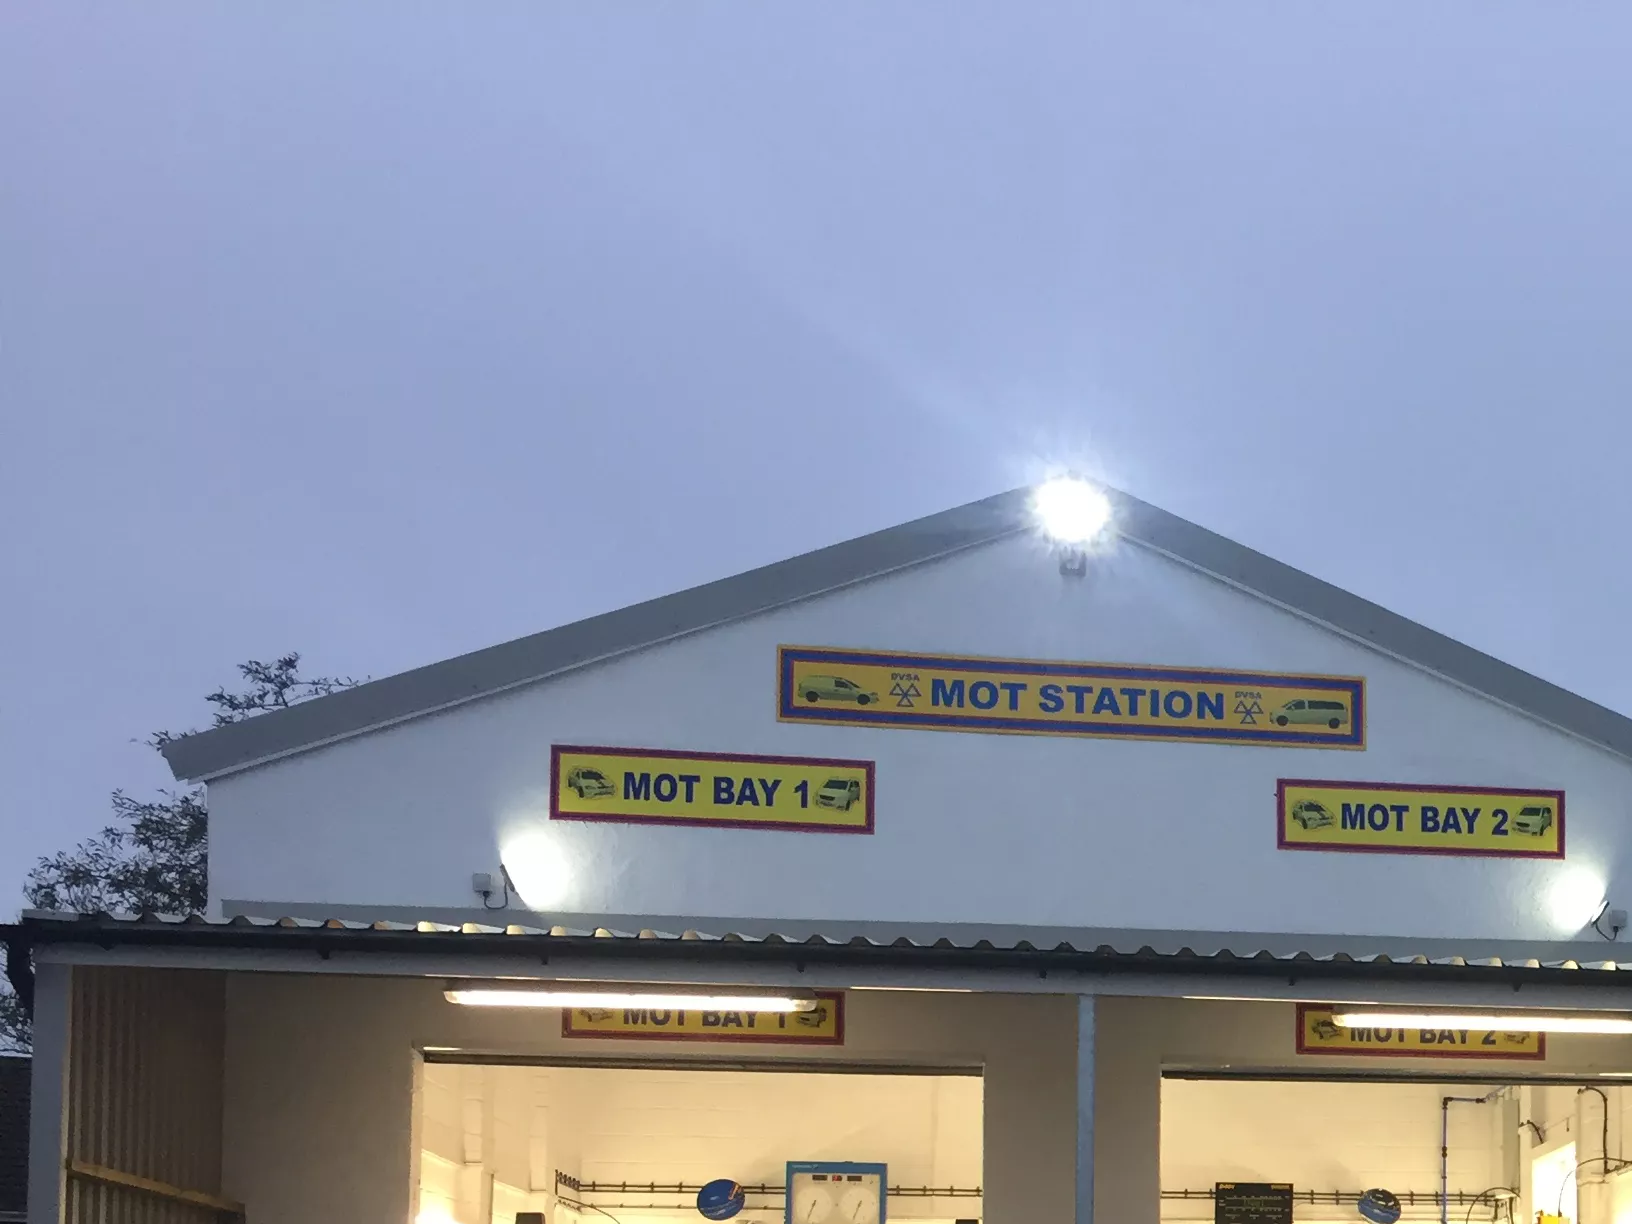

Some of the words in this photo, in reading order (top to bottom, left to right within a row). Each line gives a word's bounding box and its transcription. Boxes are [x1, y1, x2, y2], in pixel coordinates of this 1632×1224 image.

[891, 672, 920, 682] DVSA
[930, 678, 1027, 711] MOT
[1038, 684, 1226, 721] STATION
[1234, 691, 1262, 700] DVSA
[622, 771, 700, 803] MOT
[713, 776, 782, 807] BAY
[793, 780, 809, 808] 1
[1341, 803, 1410, 831] MOT
[1420, 806, 1482, 834] BAY
[1491, 809, 1509, 836] 2
[623, 1008, 685, 1026] MOT
[701, 1009, 758, 1028] BAY
[1351, 1027, 1405, 1043] MOT
[1419, 1028, 1467, 1045] BAY
